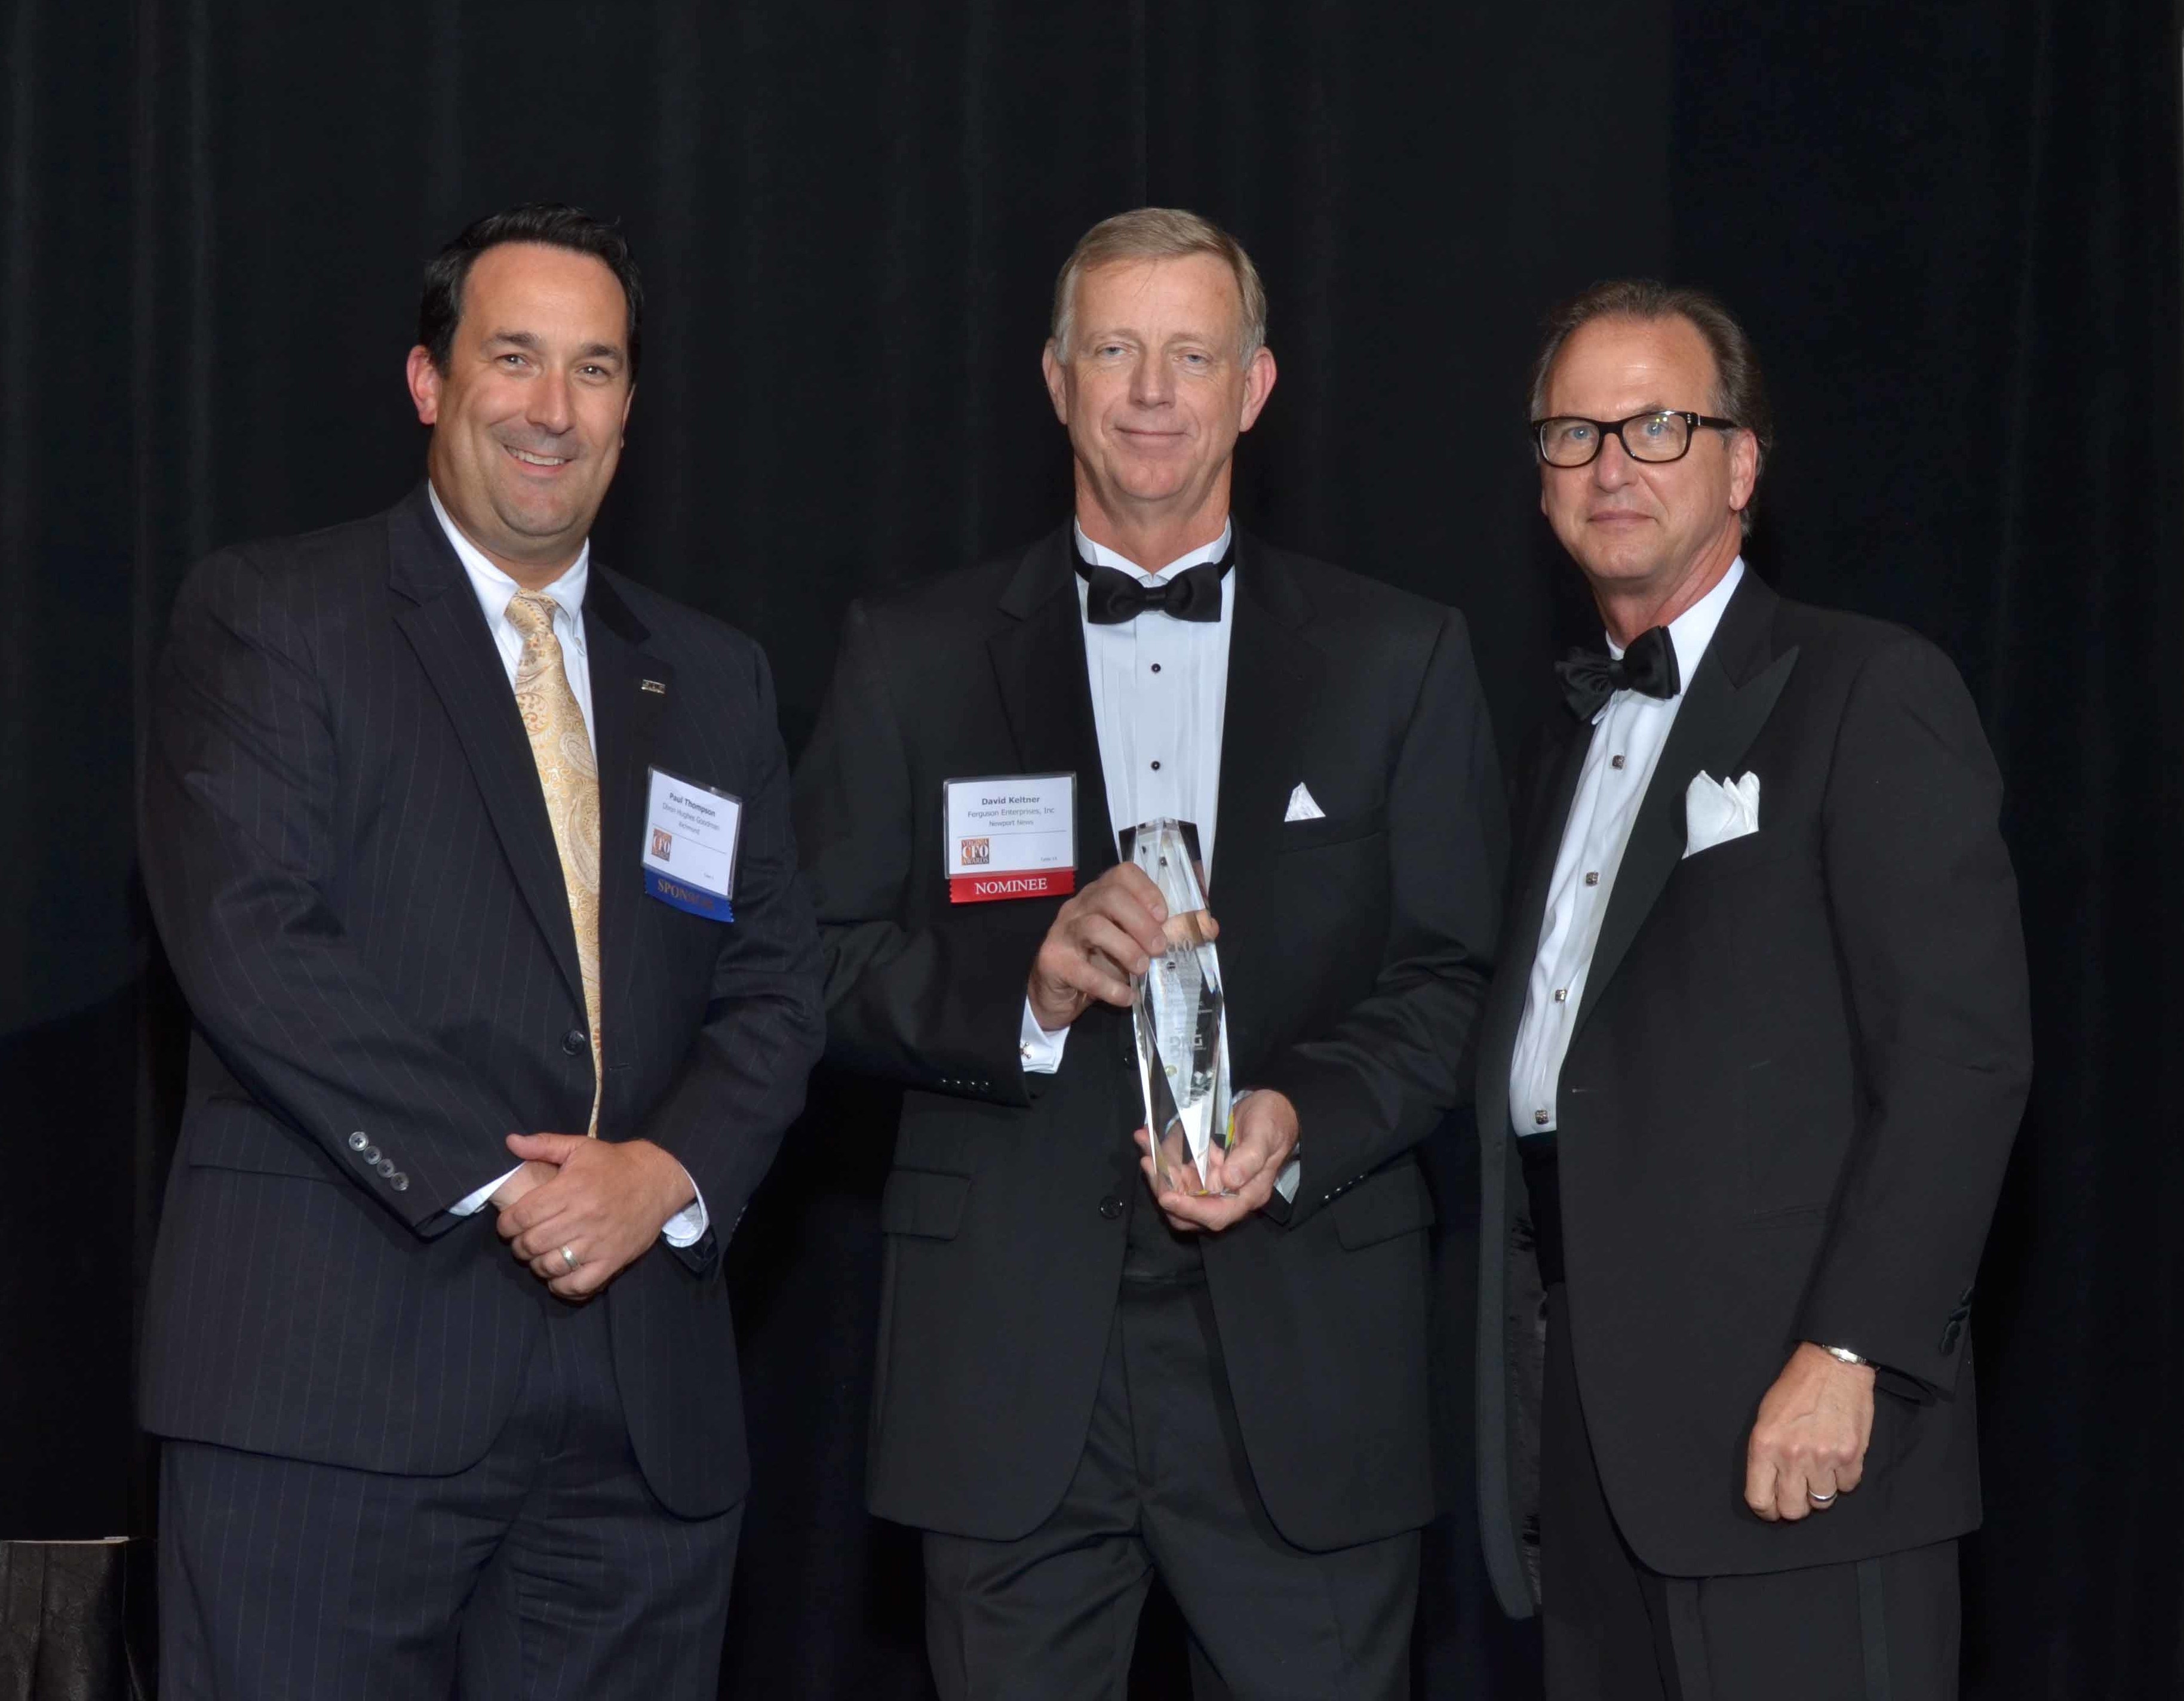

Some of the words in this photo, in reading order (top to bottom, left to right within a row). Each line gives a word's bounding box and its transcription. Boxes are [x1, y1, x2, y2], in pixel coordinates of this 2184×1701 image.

[669, 792, 683, 804] Paul
[684, 798, 715, 817] Thompson
[982, 796, 1006, 805] David
[1009, 796, 1040, 804] Keltner
[967, 810, 999, 819] Ferguson
[962, 845, 988, 859] CFO
[975, 878, 1048, 895] NOMINEE
[658, 878, 715, 911] SPON
